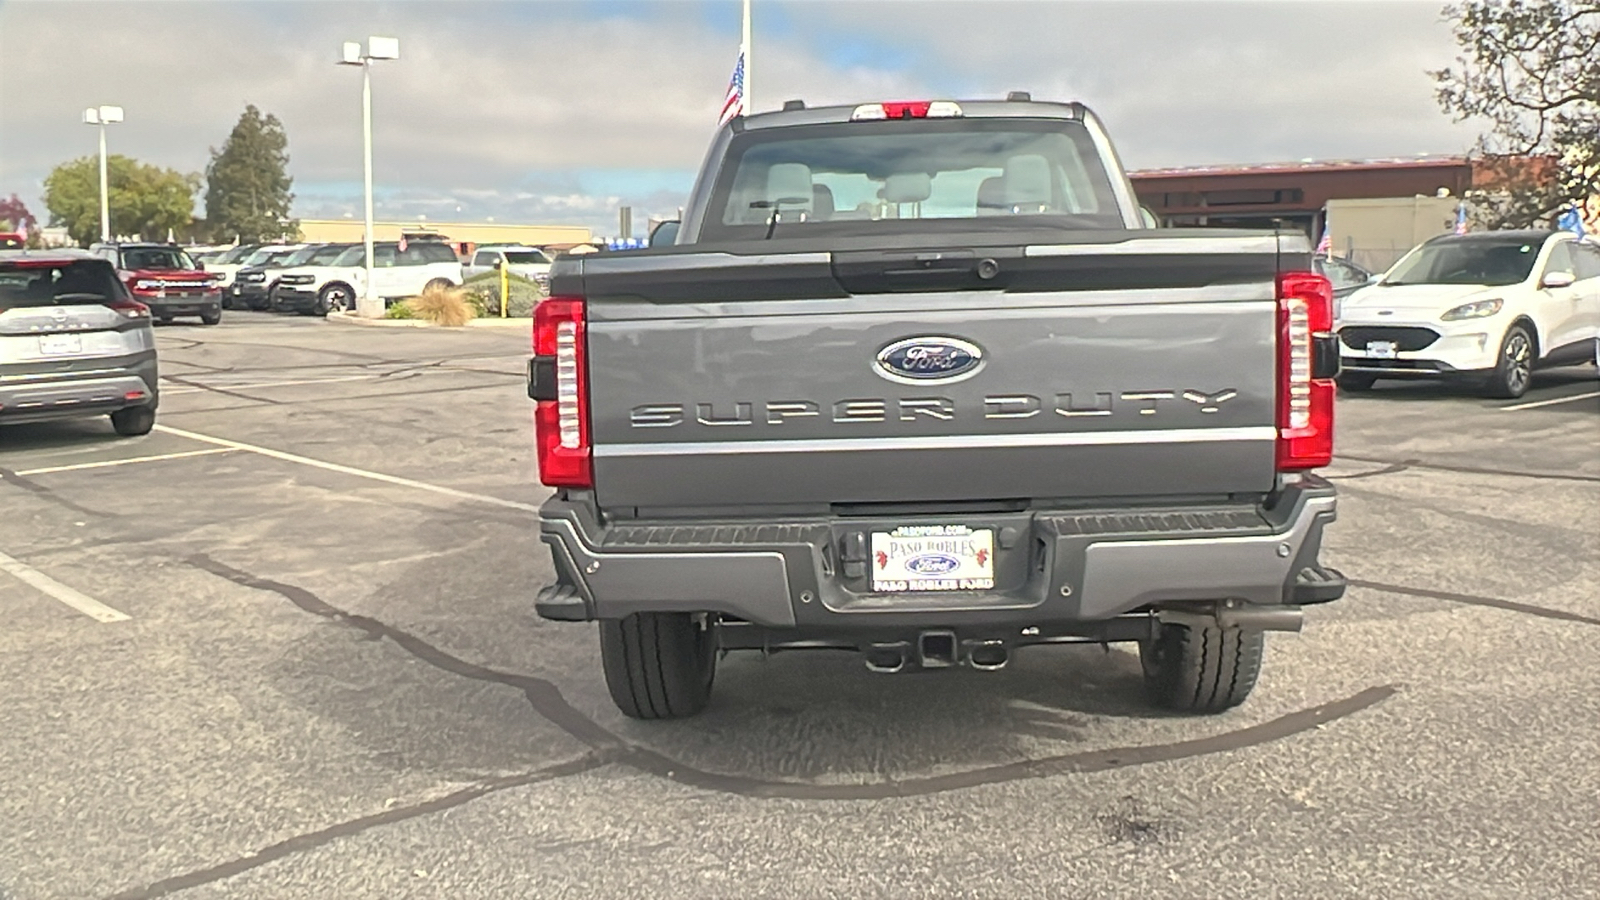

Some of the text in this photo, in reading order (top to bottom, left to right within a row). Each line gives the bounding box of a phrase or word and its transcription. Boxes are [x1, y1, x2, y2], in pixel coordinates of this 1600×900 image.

[902, 346, 957, 369] Ford
[631, 390, 1237, 427] SUPER DUTY
[890, 540, 976, 559] PASO ROBLES
[916, 558, 951, 572] Ford
[874, 578, 994, 592] PASO ROBLES FORD
